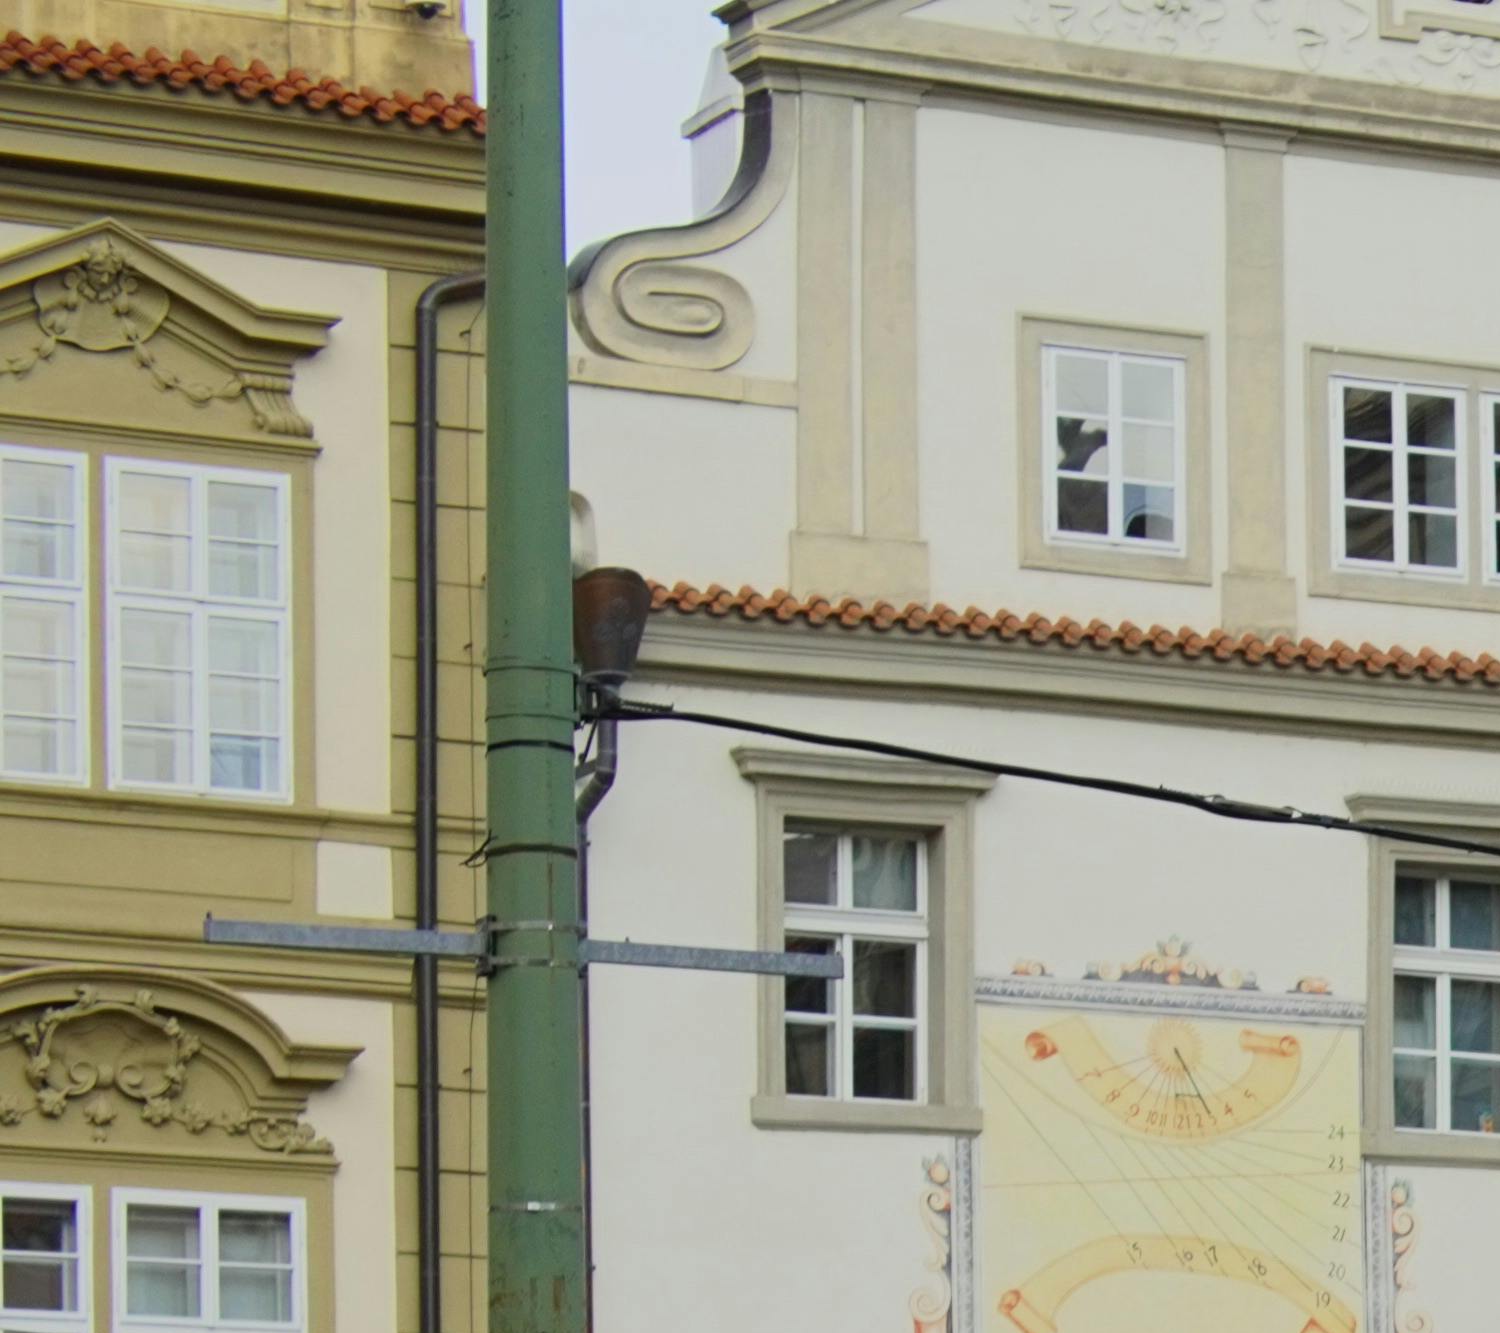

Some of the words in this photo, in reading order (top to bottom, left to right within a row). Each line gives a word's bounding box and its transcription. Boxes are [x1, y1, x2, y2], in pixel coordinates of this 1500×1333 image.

[1223, 1103, 1234, 1116] 4
[1328, 1124, 1346, 1141] 24
[1328, 1154, 1345, 1172] 23
[1332, 1190, 1351, 1209] 22
[1332, 1225, 1347, 1243] 21
[1328, 1262, 1347, 1280] 20
[1315, 1291, 1331, 1308] 19
